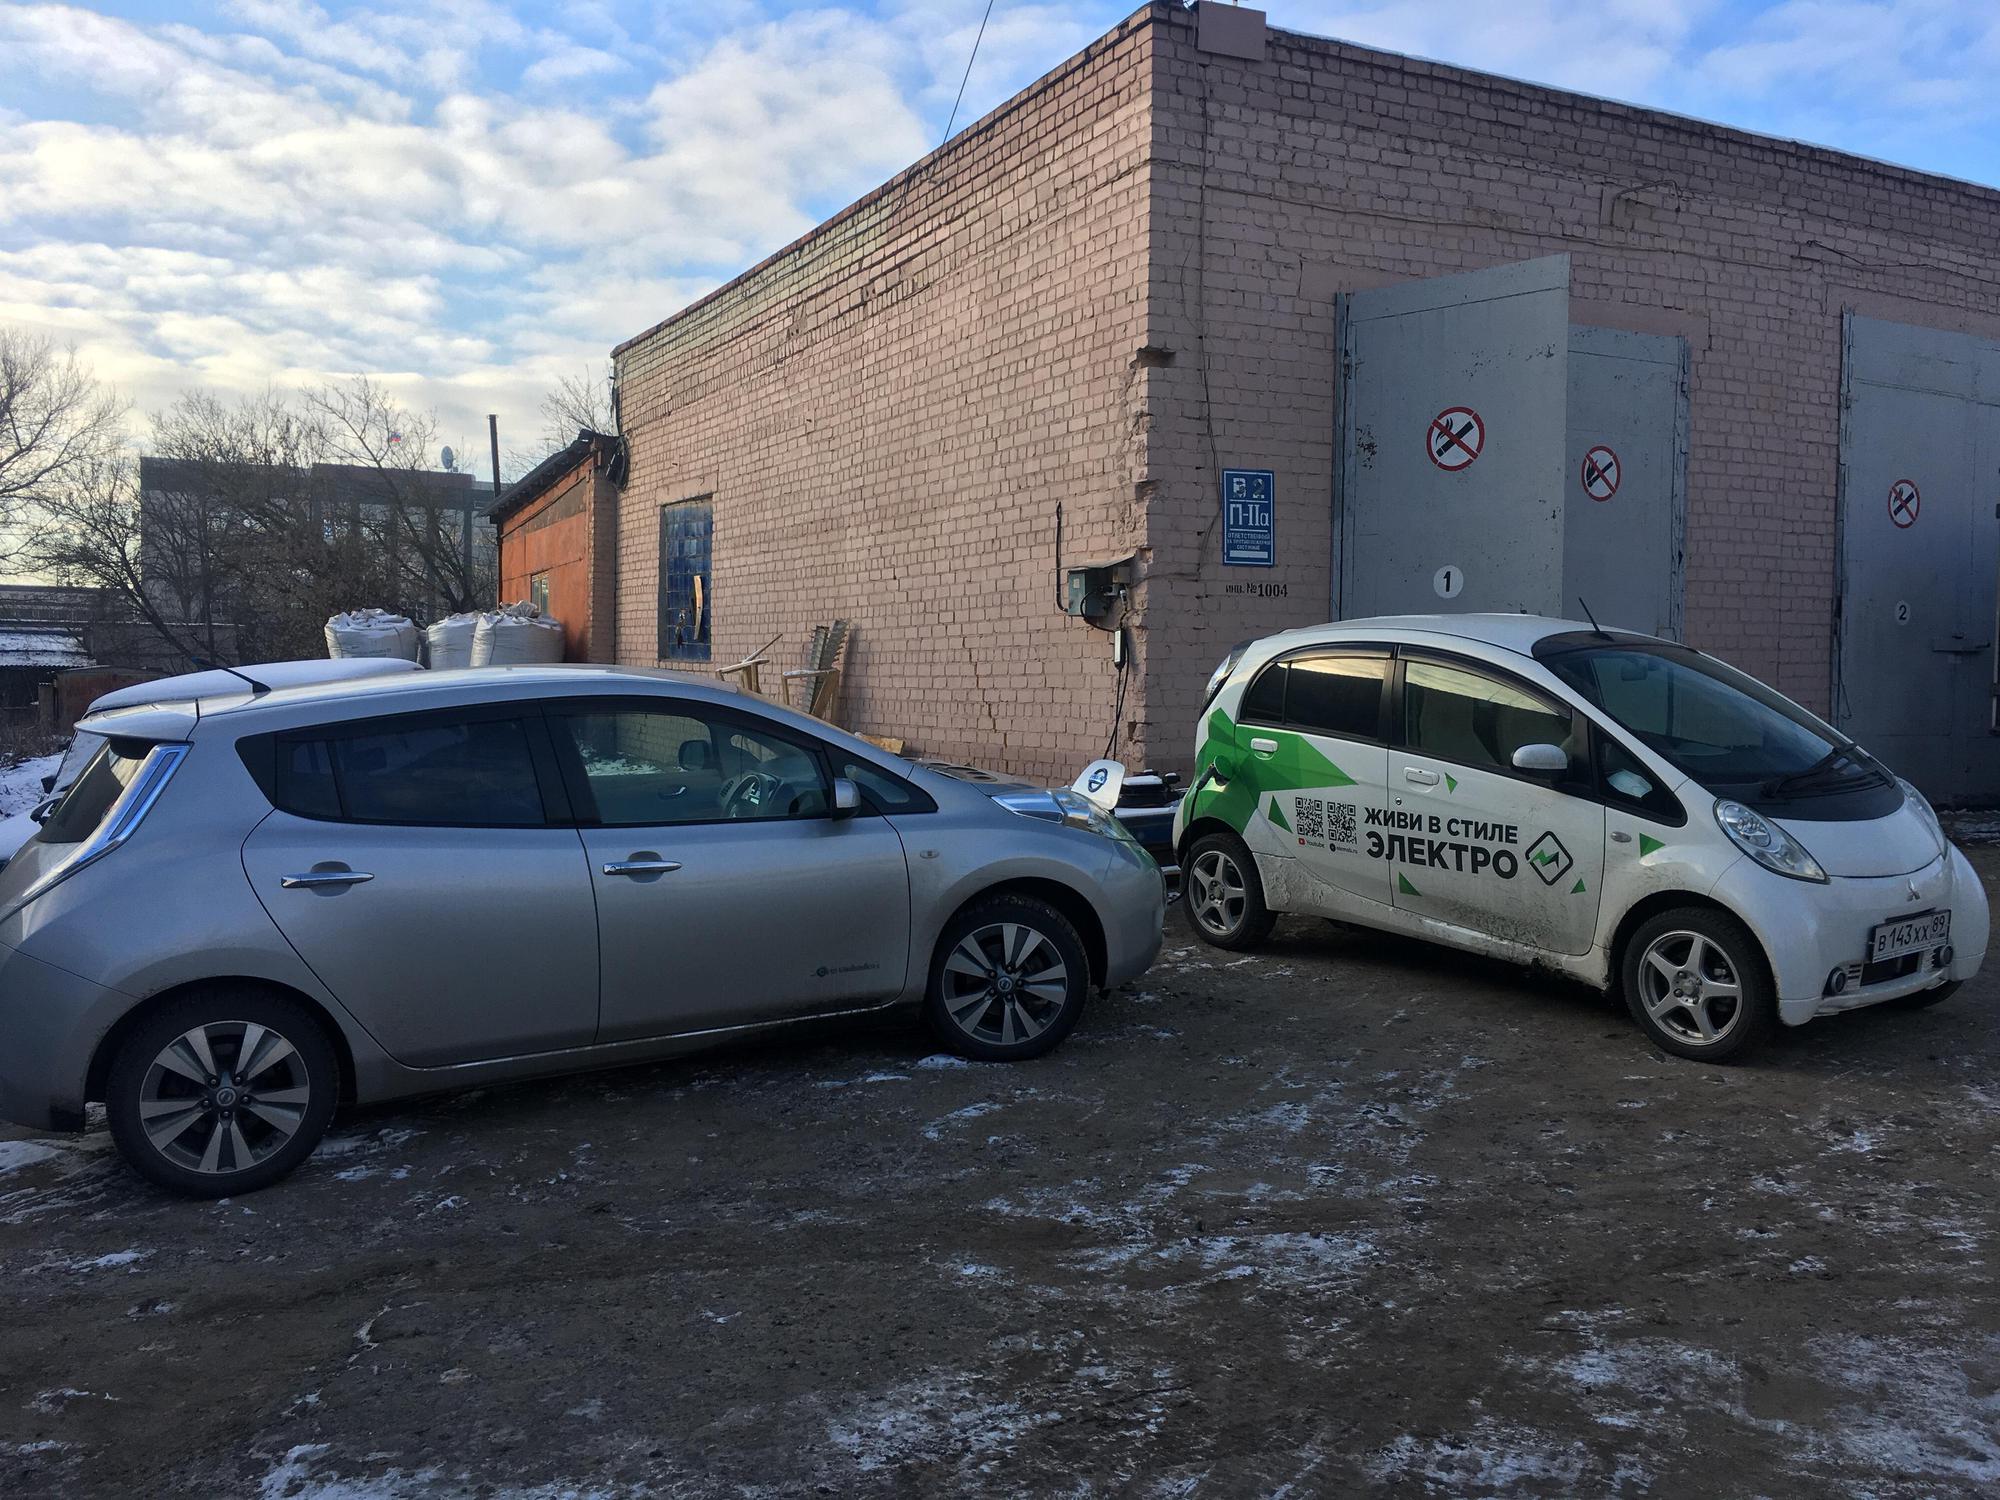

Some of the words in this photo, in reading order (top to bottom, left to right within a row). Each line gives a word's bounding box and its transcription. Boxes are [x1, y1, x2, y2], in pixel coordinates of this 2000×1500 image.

[1443, 570, 1451, 593] 1
[1899, 604, 1907, 620] 2
[1364, 806, 1423, 832] ЖИВИ
[1429, 815, 1442, 834] В
[1446, 817, 1518, 845] СТИЛЕ
[1366, 831, 1519, 880] ЭЛЕКТРО
